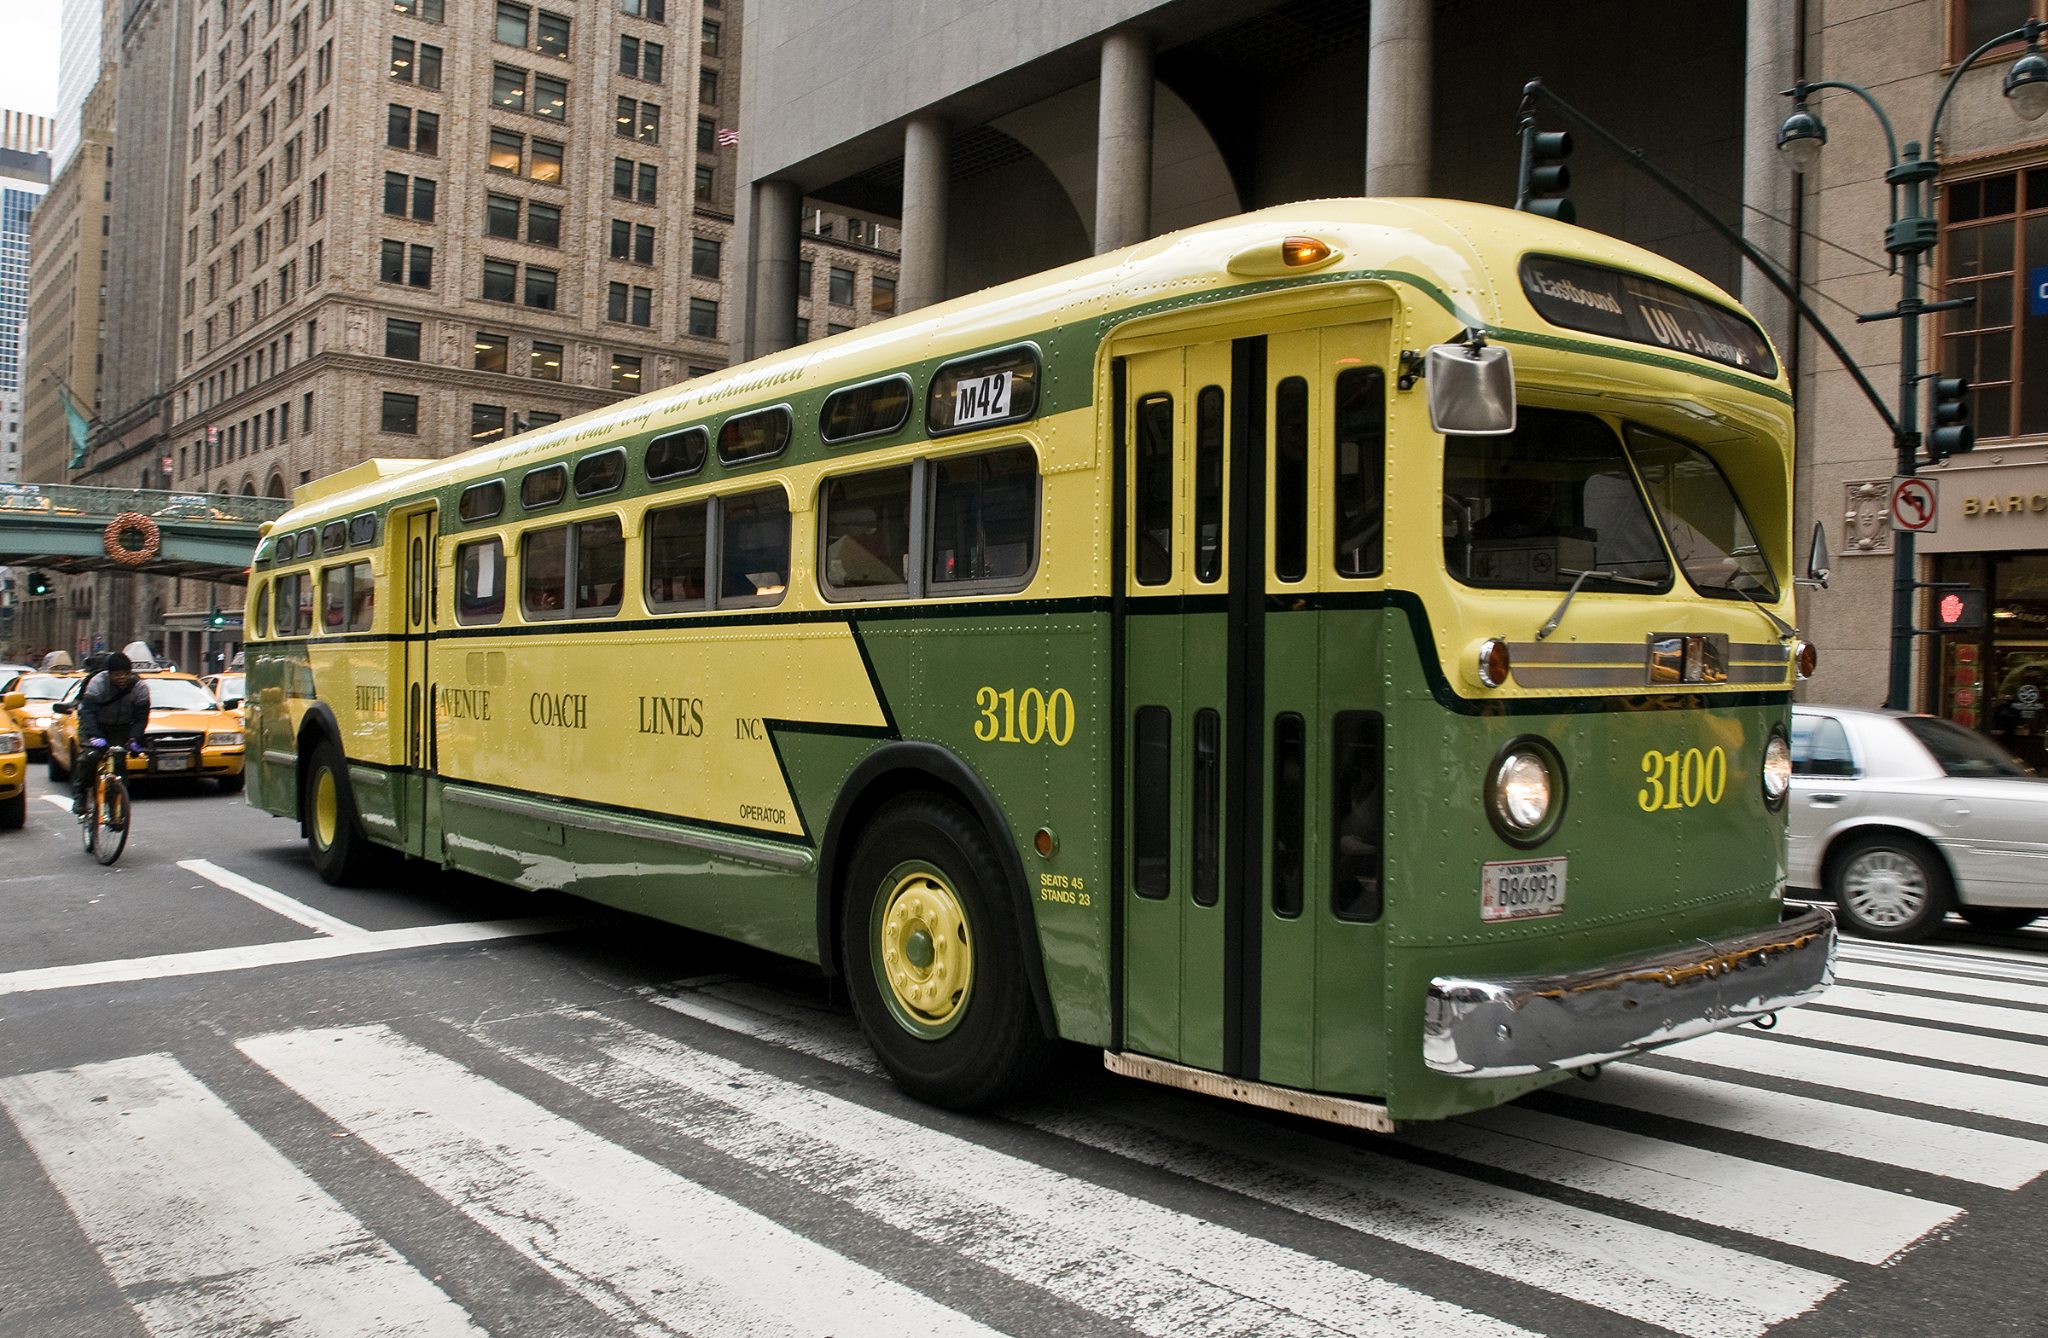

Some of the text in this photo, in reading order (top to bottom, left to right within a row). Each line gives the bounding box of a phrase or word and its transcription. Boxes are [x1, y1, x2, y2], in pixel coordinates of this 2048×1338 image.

[1533, 270, 1623, 315] Eastbound
[958, 373, 1005, 421] M42
[356, 685, 763, 741] FIFTH AVENUE COACH LINES INC.
[974, 685, 1075, 747] 3100
[1637, 745, 1728, 813] 3100
[739, 803, 787, 825] OPERATOR
[1040, 873, 1084, 890] SEATS 45
[1041, 888, 1091, 906] STANDS 23
[1498, 873, 1558, 907] B86993
